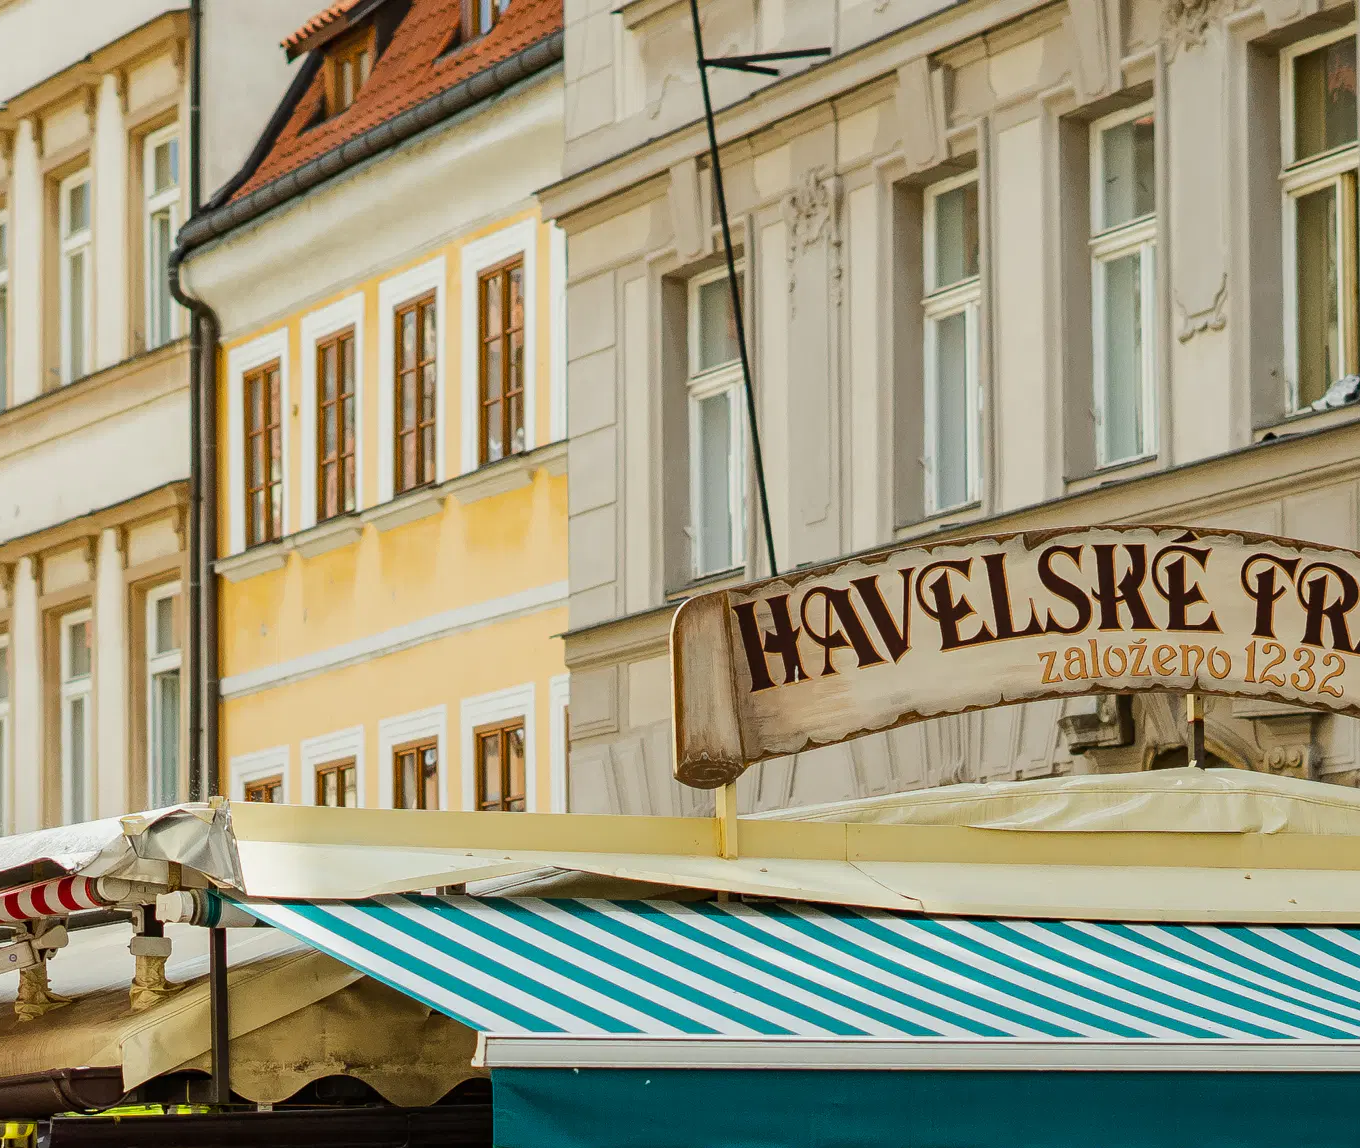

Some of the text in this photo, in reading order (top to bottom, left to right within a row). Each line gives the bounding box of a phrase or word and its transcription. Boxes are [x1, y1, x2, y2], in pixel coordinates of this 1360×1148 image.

[732, 530, 1224, 693] HAVELSKÉ
[1037, 638, 1346, 698] založeno 1232
